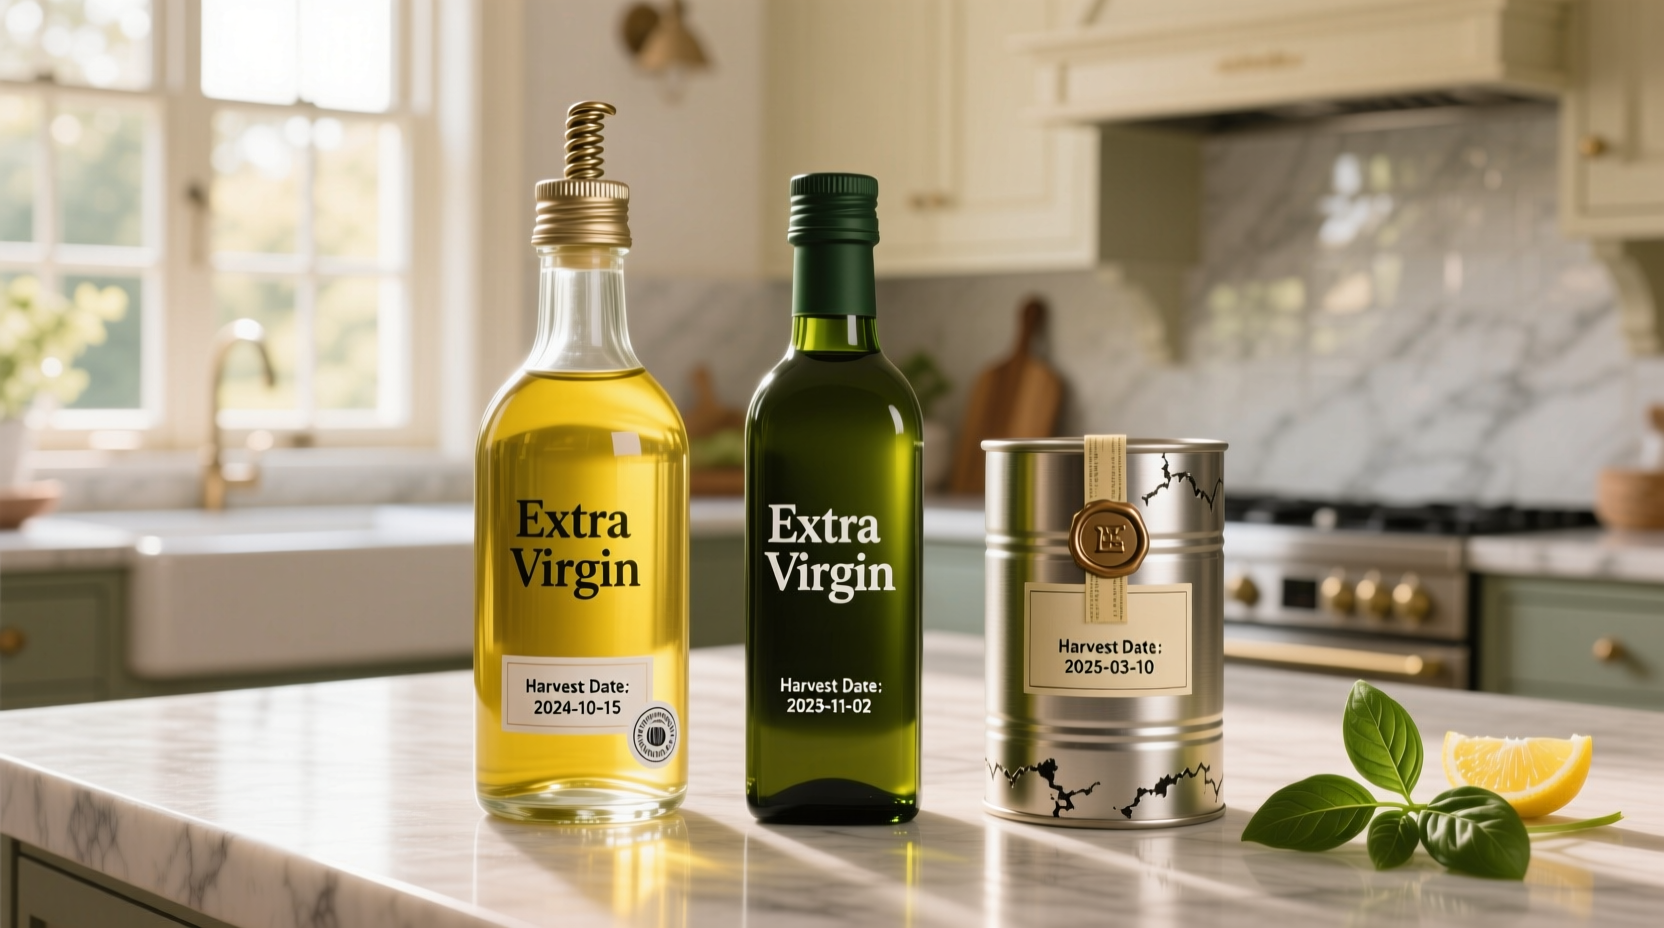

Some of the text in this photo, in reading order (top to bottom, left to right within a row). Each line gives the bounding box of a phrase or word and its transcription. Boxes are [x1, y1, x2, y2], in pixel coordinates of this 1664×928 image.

[516, 499, 632, 539] Extra
[768, 504, 881, 544] Extra
[510, 548, 641, 600] Virgin
[764, 552, 897, 604] Virgin
[1058, 638, 1163, 655] Harvest Date:
[1064, 658, 1155, 675] 2025-03-10
[525, 678, 630, 694] Harvest Date:
[780, 677, 883, 694] Harvest Date:
[533, 699, 622, 715] 2024-10-15
[786, 698, 872, 714] 2023-11-02
